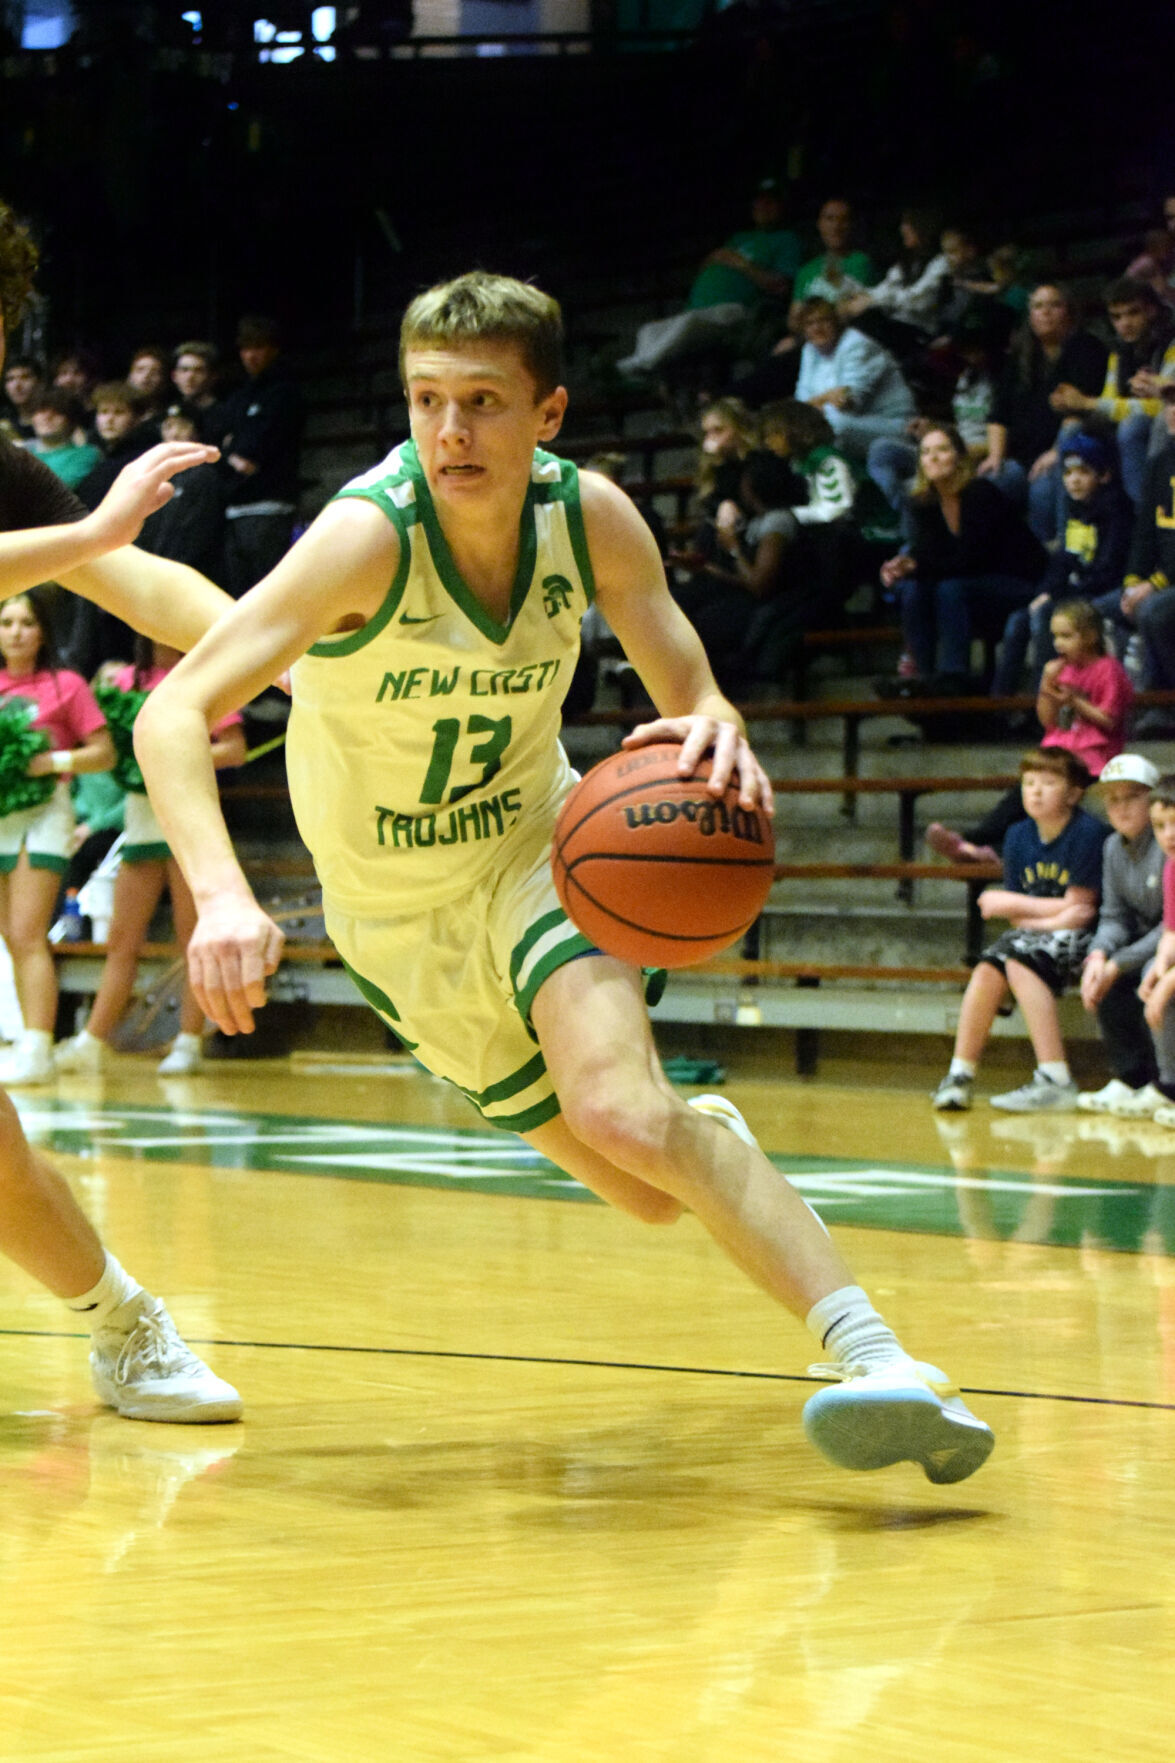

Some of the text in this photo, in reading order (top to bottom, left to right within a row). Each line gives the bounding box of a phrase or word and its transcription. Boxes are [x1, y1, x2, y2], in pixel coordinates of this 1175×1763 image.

[375, 666, 461, 702] NEW
[419, 714, 512, 804] 13
[624, 800, 763, 844] Wilson
